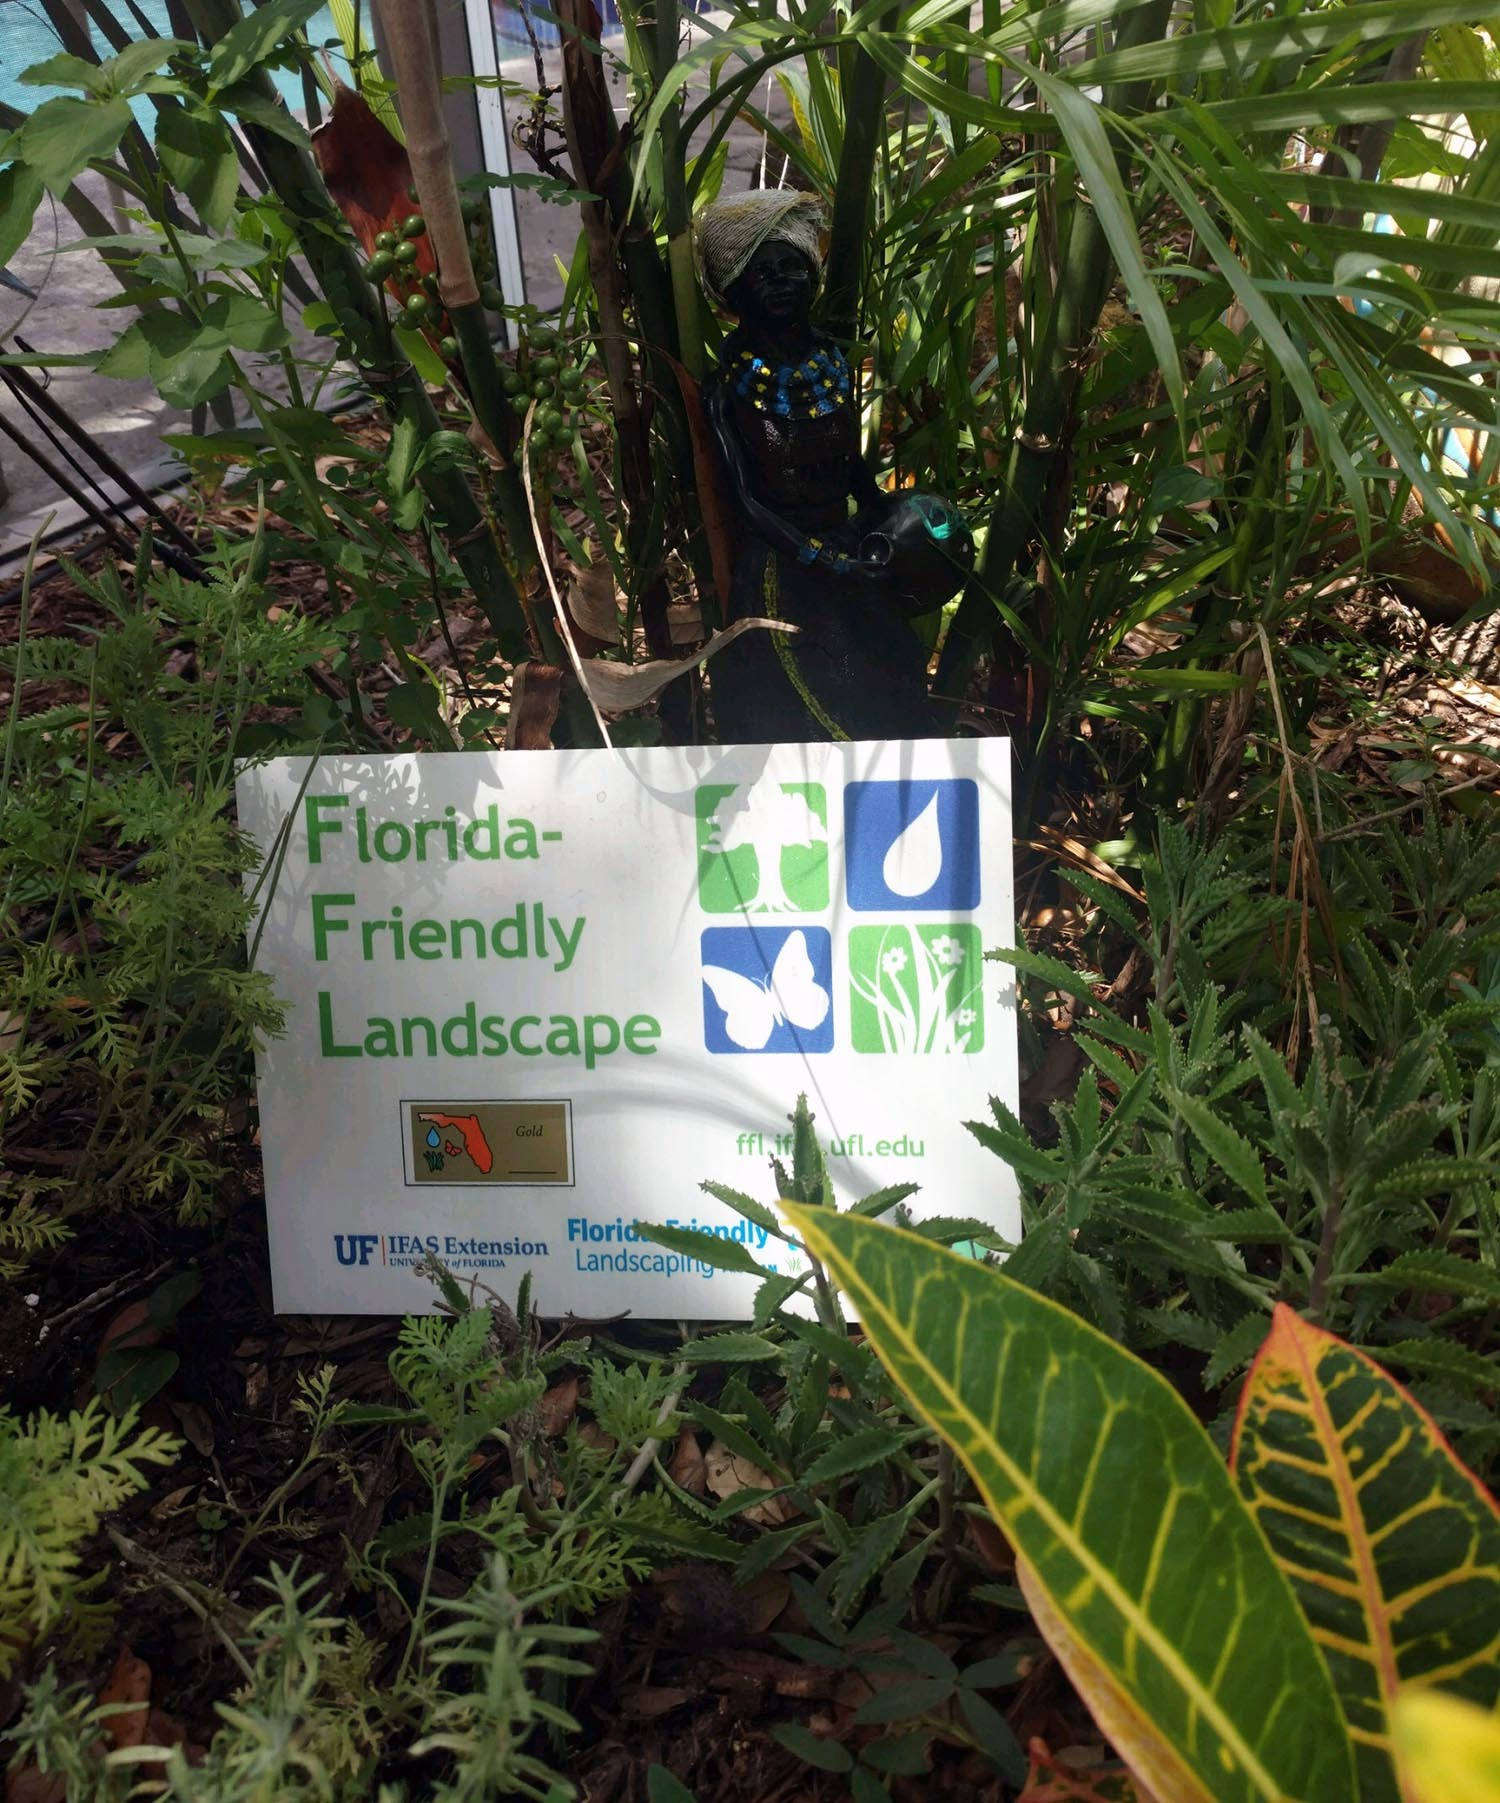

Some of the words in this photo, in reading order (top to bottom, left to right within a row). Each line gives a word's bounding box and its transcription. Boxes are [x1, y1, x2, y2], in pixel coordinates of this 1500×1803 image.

[305, 795, 563, 864] Florida-
[311, 894, 586, 972] Friendly
[318, 991, 662, 1070] Landscape
[515, 1125, 543, 1137] Gold
[334, 1235, 378, 1266] UF
[388, 1236, 438, 1254] IFAS
[444, 1236, 549, 1256] Extension
[463, 1258, 505, 1269] FLORIDA
[576, 1247, 713, 1278] Landscaping
